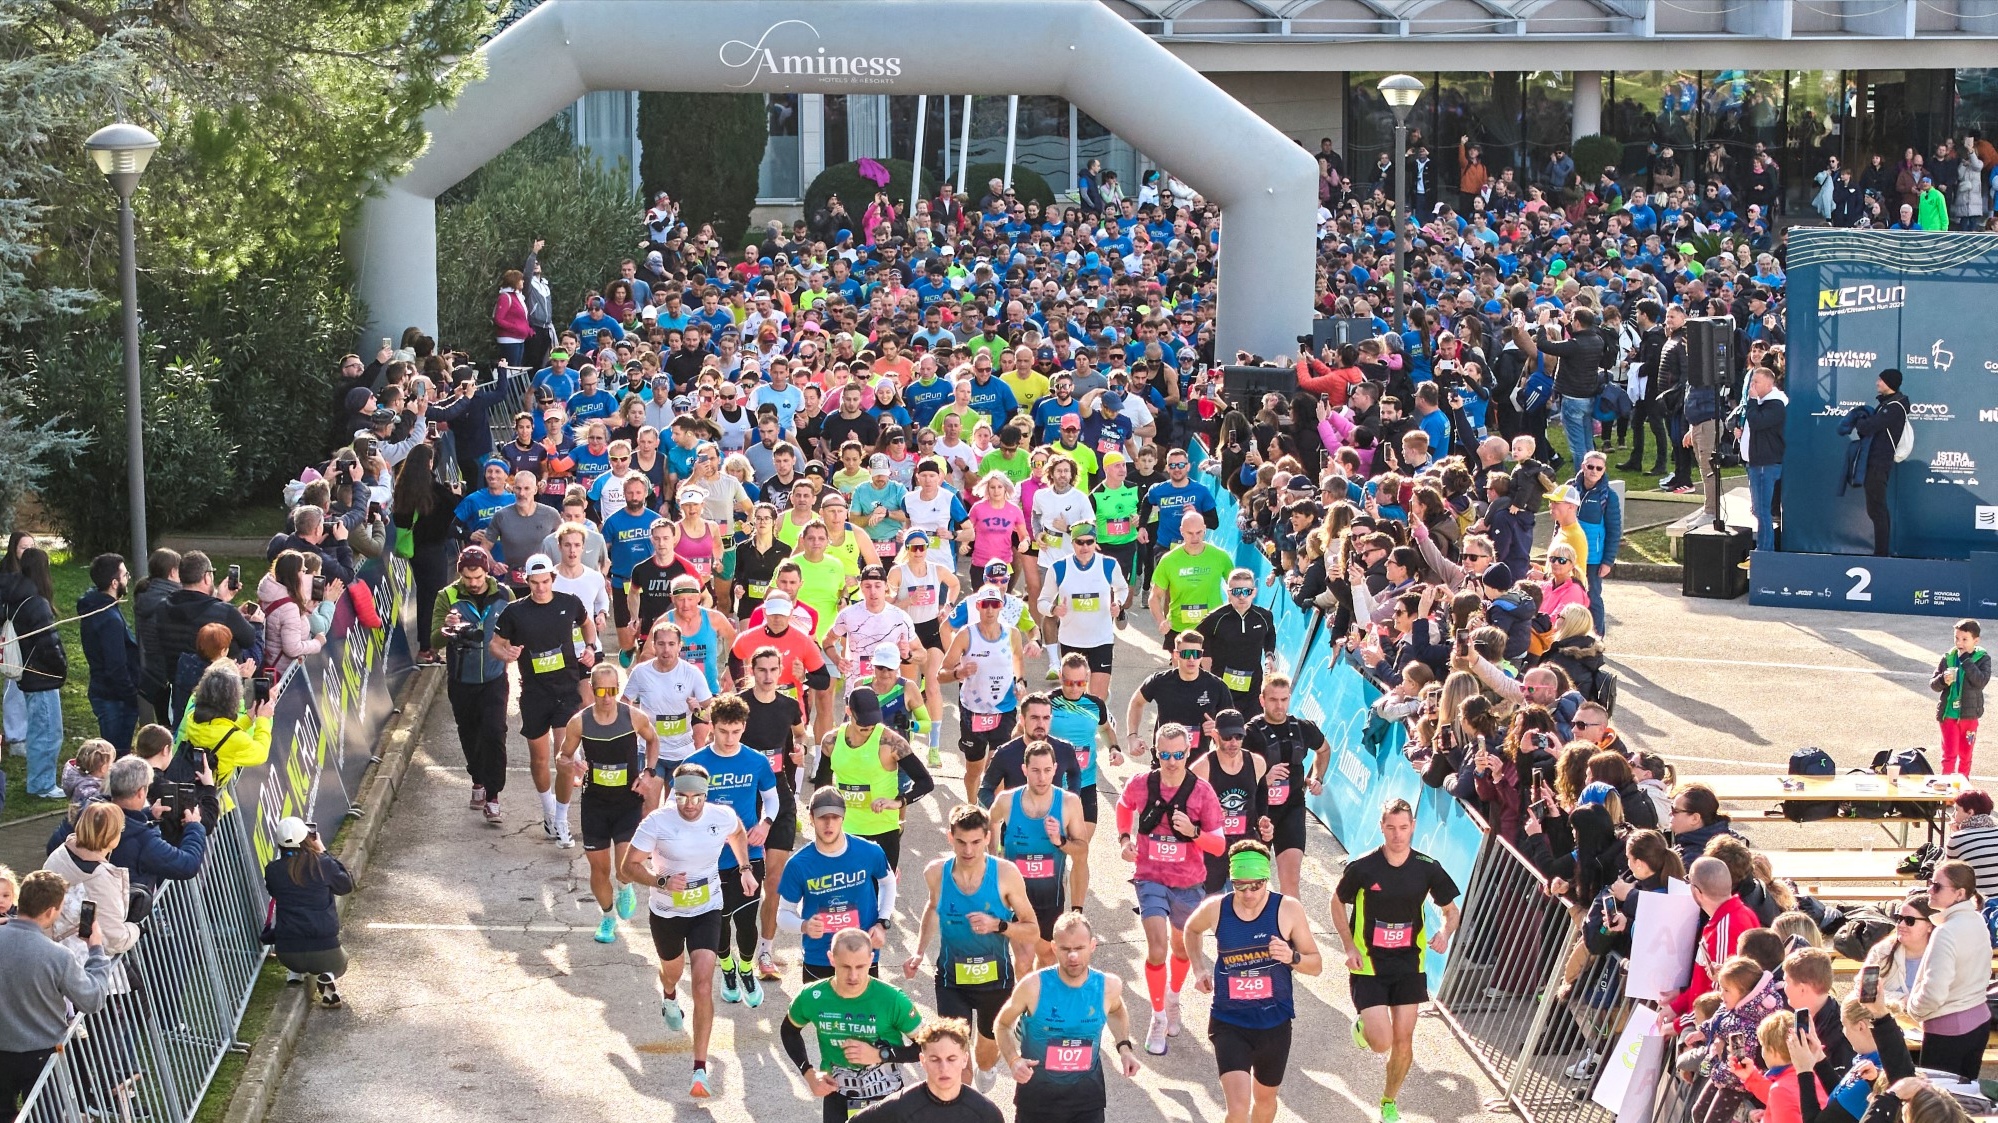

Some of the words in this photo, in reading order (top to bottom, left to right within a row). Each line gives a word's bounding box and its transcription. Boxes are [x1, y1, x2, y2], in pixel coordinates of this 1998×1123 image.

[1818, 284, 1906, 310] NCRun
[1826, 350, 1877, 361] NOVIGRAD
[1906, 354, 1928, 365] Istra
[914, 392, 942, 402] NCRun
[575, 402, 604, 413] NCRun
[1937, 451, 1969, 461] ISTRA
[1931, 459, 1975, 468] ADVENTURE
[1160, 495, 1196, 506] NCRun
[875, 543, 891, 551] 266
[1178, 566, 1212, 576] NCRun
[1845, 566, 1872, 602] 2
[1078, 598, 1093, 607] 741
[1914, 598, 1930, 606] Run
[1187, 610, 1202, 618] 631
[538, 655, 559, 667] 472
[1231, 675, 1246, 686] 713
[663, 721, 680, 730] 917
[980, 716, 994, 726] 36
[598, 770, 620, 780] 467
[1267, 786, 1283, 798] 02
[1224, 818, 1240, 828] 99
[1156, 842, 1178, 855] 199
[1025, 861, 1043, 872] 151
[806, 869, 866, 891] NCRun
[826, 913, 852, 925] 256
[1383, 930, 1405, 941] 158
[963, 963, 990, 976] 769
[1235, 978, 1264, 991] 248
[847, 1023, 877, 1034] TEAM
[1057, 1048, 1083, 1062] 107
